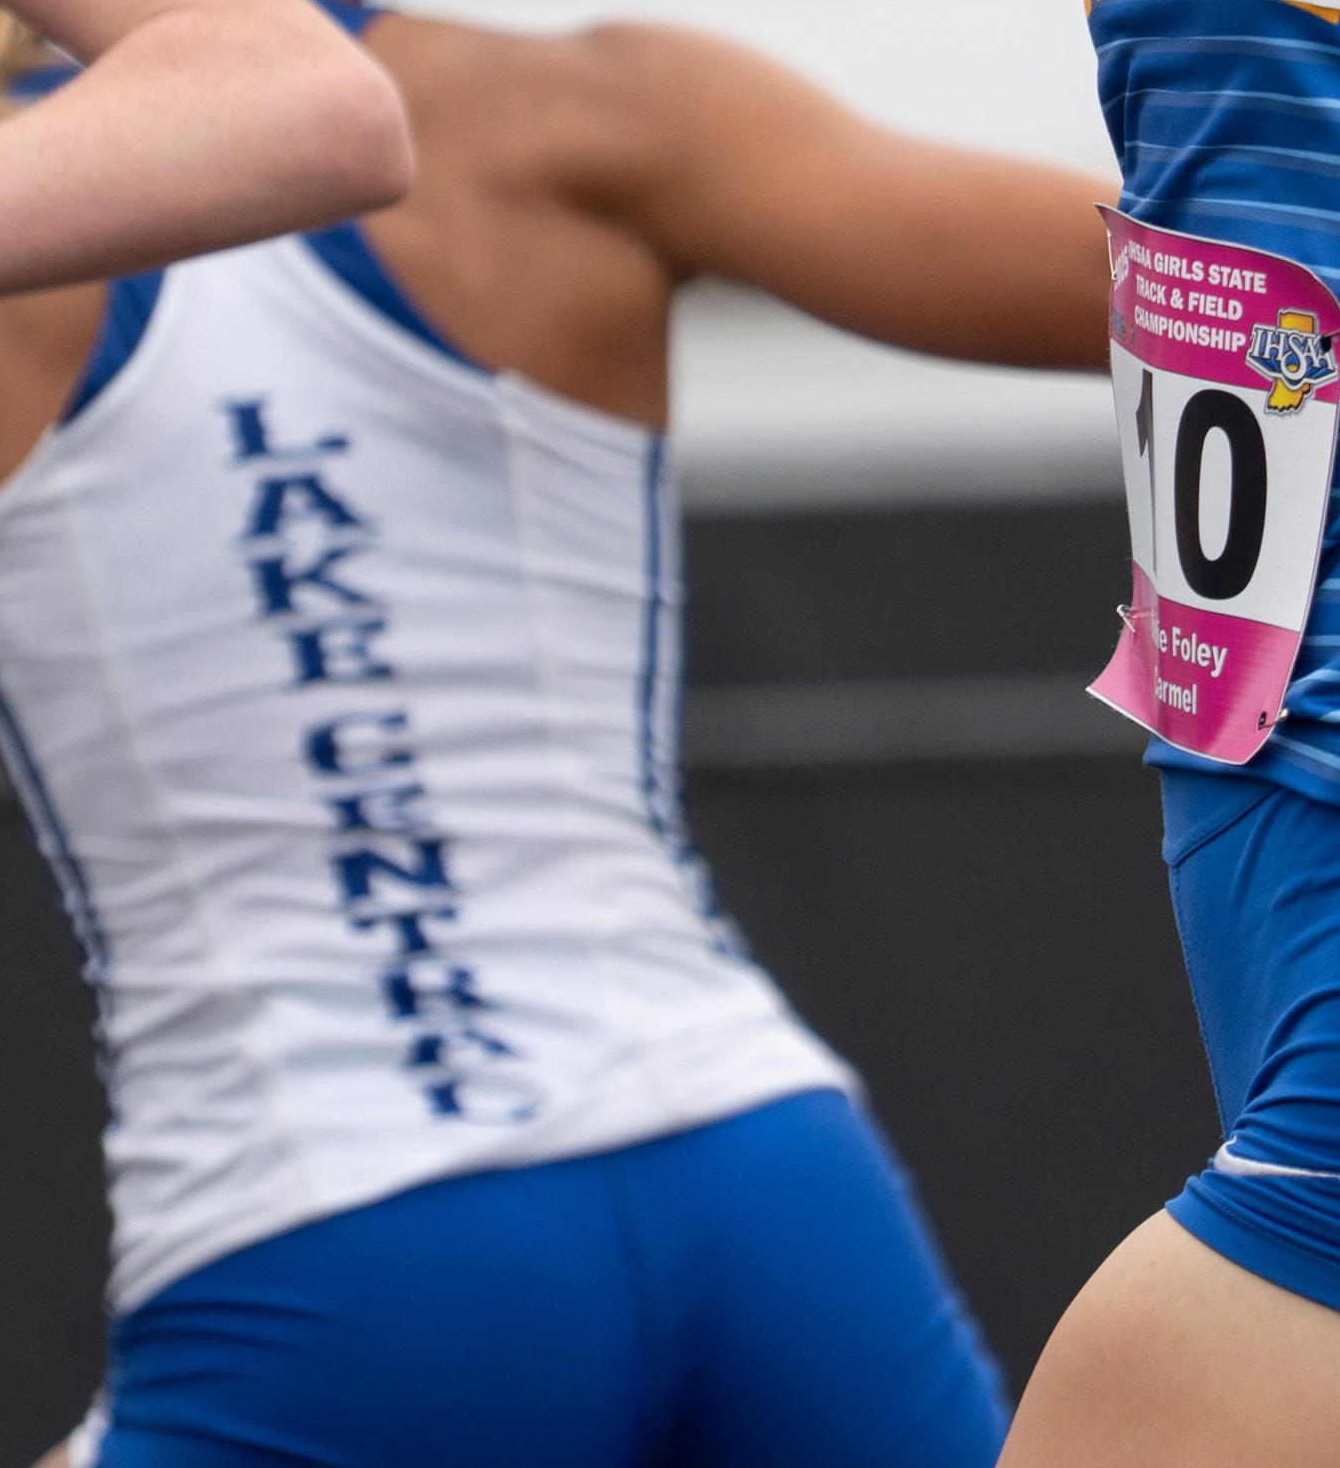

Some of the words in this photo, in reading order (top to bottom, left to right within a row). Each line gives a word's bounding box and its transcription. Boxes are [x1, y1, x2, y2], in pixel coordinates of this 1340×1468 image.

[1128, 239, 1151, 269] IHSAA
[1154, 252, 1204, 282] GIRLS
[1208, 263, 1267, 294] STATE
[1136, 274, 1166, 306] TRACK
[1170, 288, 1183, 309] &
[1188, 292, 1243, 321] FIELD
[1134, 305, 1246, 352] CHAMPIONSHIP
[1136, 368, 1267, 600] 10
[219, 397, 397, 685] LAKE
[1171, 626, 1228, 678] Foley
